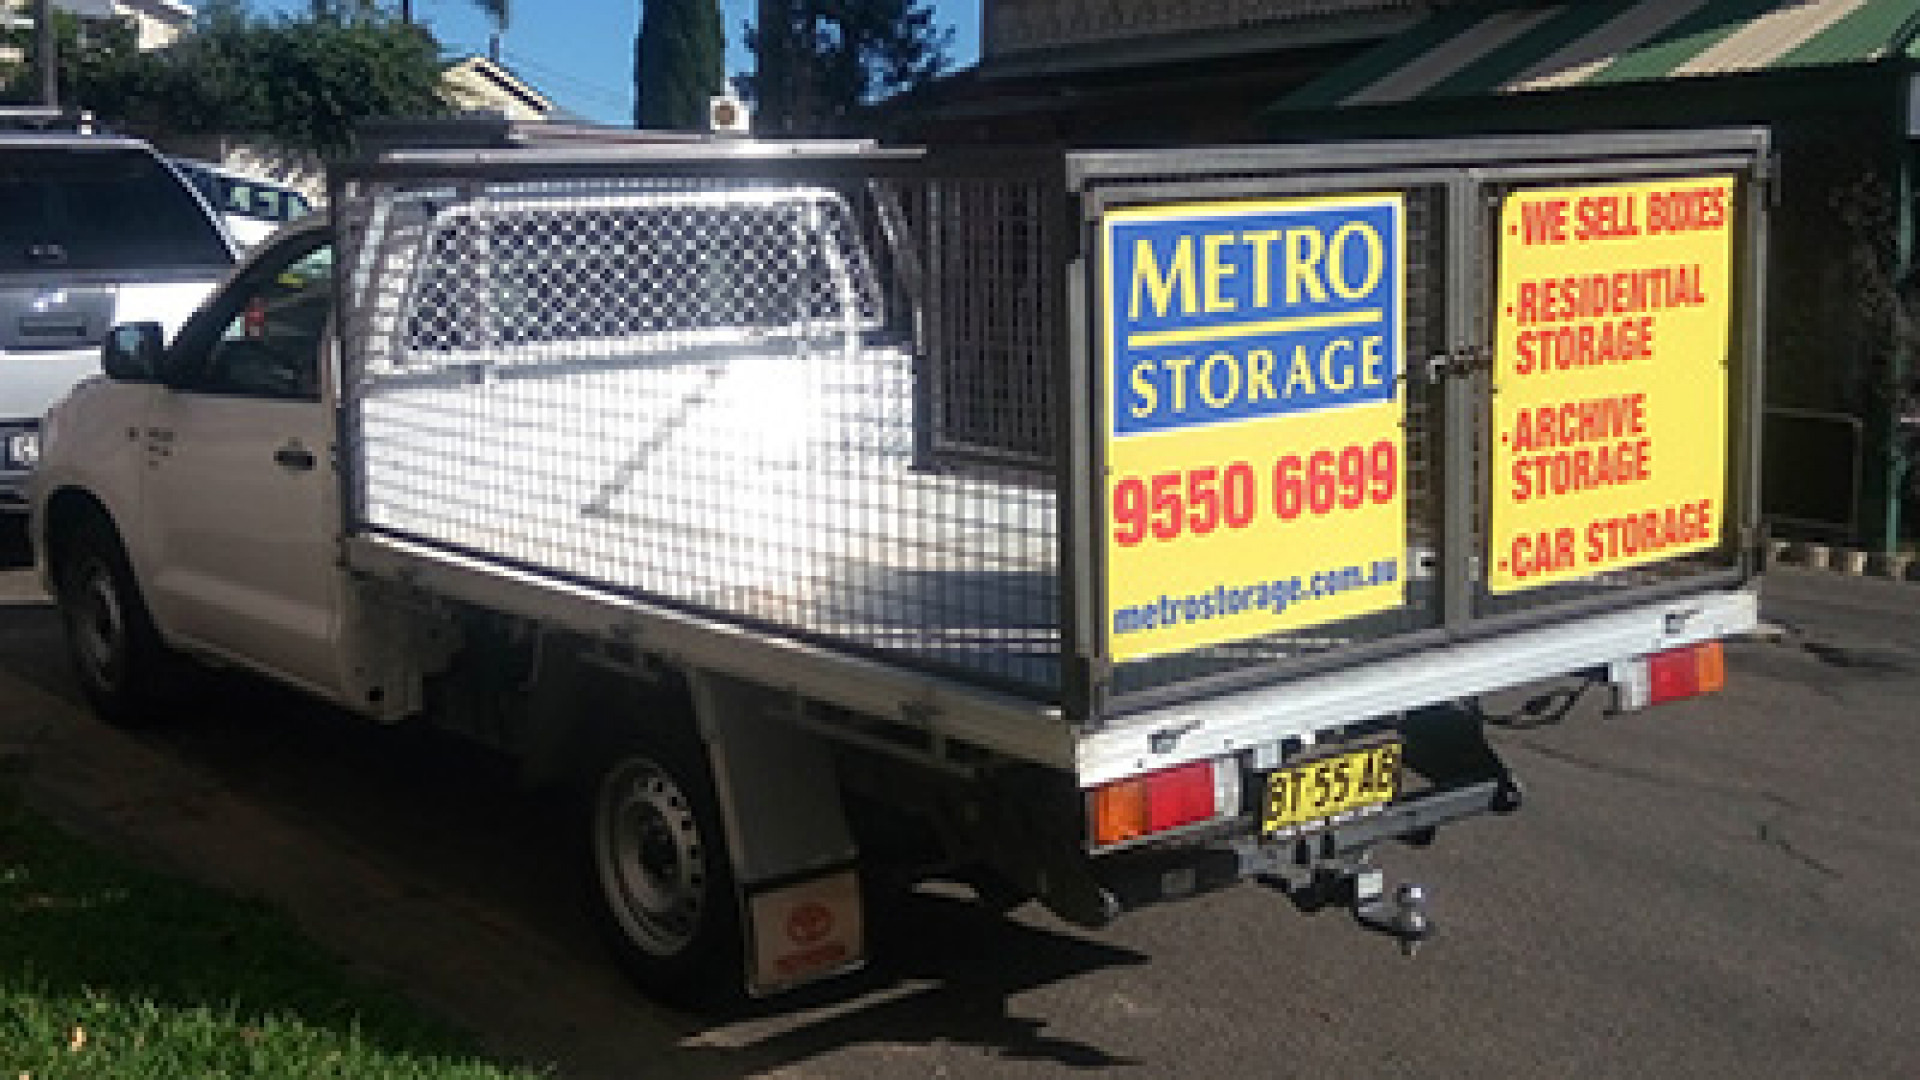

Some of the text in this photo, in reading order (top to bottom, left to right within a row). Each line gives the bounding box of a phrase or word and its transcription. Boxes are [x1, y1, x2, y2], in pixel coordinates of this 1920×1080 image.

[1521, 187, 1724, 245] WE SELL BOXES
[1127, 220, 1384, 321] METRO
[1516, 264, 1705, 325] RESIDENTIAL
[1129, 336, 1382, 418] STORAGE
[1516, 317, 1653, 374] STORAGE
[1511, 393, 1648, 452] ARCHIVE
[1112, 440, 1397, 546] 9550 6699
[1511, 438, 1651, 503] STORAGE
[1511, 500, 1711, 580] CAR STORAGE
[1112, 559, 1397, 634] metrostorage.com.au
